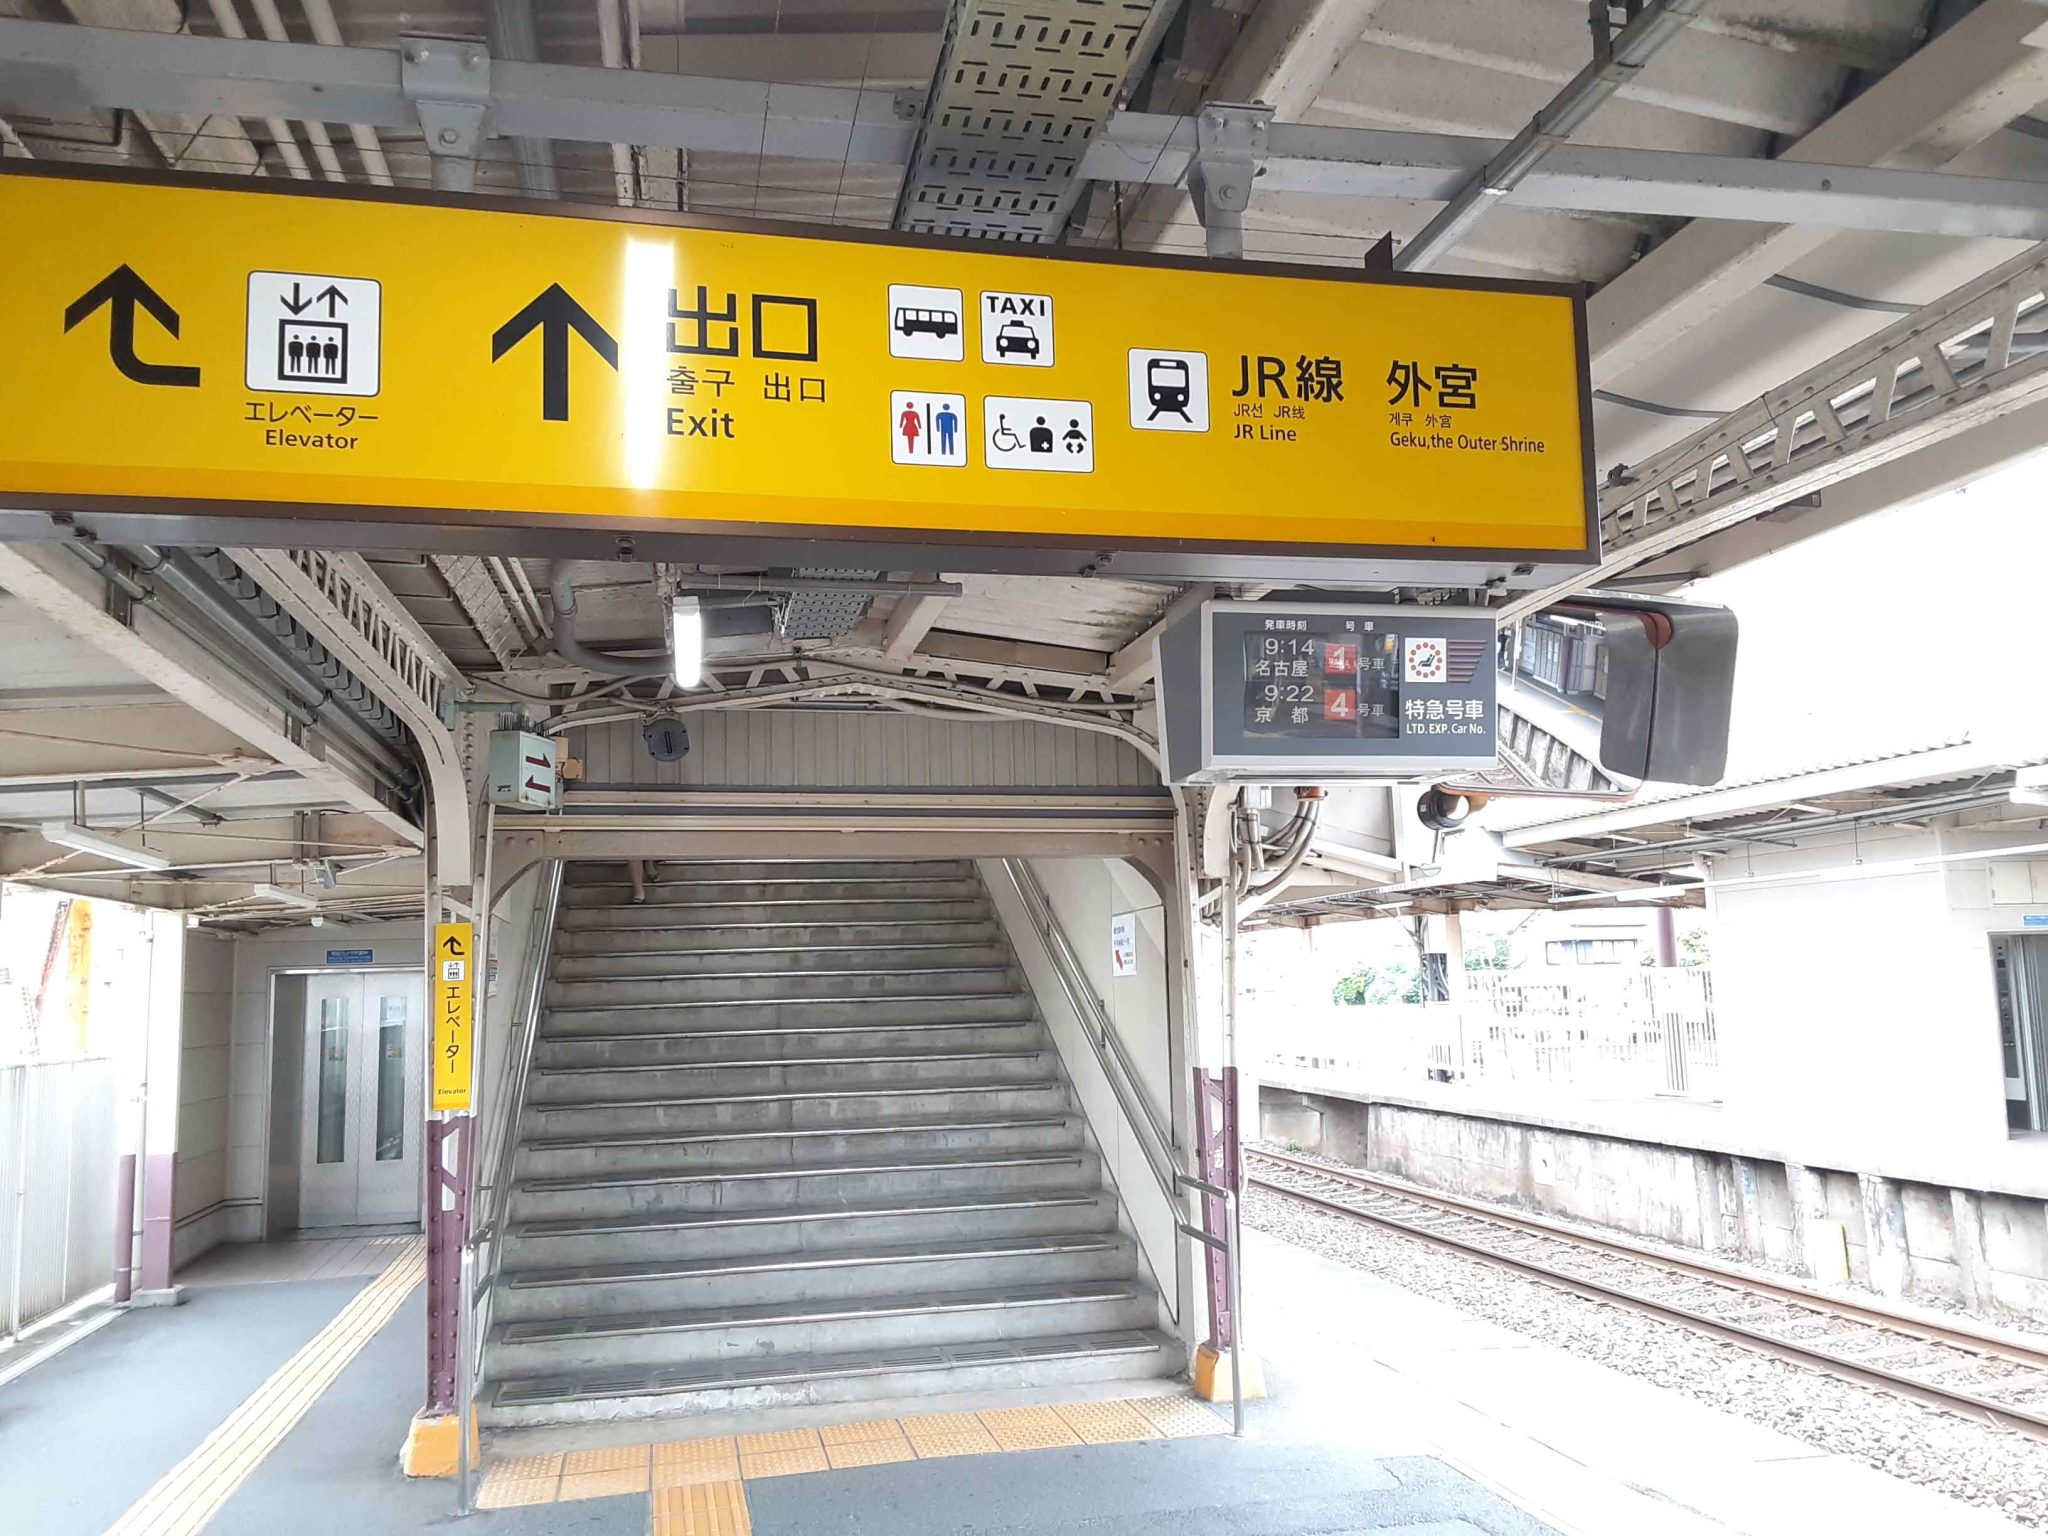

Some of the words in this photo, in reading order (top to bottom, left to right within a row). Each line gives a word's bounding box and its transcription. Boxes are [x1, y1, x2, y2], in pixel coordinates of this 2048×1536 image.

[986, 295, 1046, 317] TAXI
[667, 286, 818, 362] 出口
[667, 365, 735, 397] 출구
[764, 372, 825, 402] 出口
[1232, 354, 1344, 403] JR線
[1386, 360, 1477, 409] 外宮
[245, 402, 379, 426] エレベーター
[1233, 403, 1263, 419] JR선
[1389, 412, 1414, 428] 게쿠
[667, 407, 735, 439] Exit
[1234, 423, 1254, 439] JR
[1260, 425, 1297, 441] Line
[265, 427, 358, 451] Elevator
[1457, 435, 1497, 451] Outer
[1501, 436, 1545, 453] Shrine
[1264, 619, 1307, 631] 発車時刻
[1264, 638, 1315, 656] 9:14
[1255, 659, 1309, 677] 名古屋
[1358, 657, 1385, 672] 号車
[1264, 684, 1314, 702] 9:22
[1331, 692, 1349, 717] 4
[1357, 703, 1385, 717] 号車
[1405, 698, 1484, 720] 特急号車
[1451, 723, 1468, 735] Car
[1469, 723, 1486, 735] No.
[445, 986, 461, 1074] エレベーター
[438, 1087, 467, 1095] Elevator
